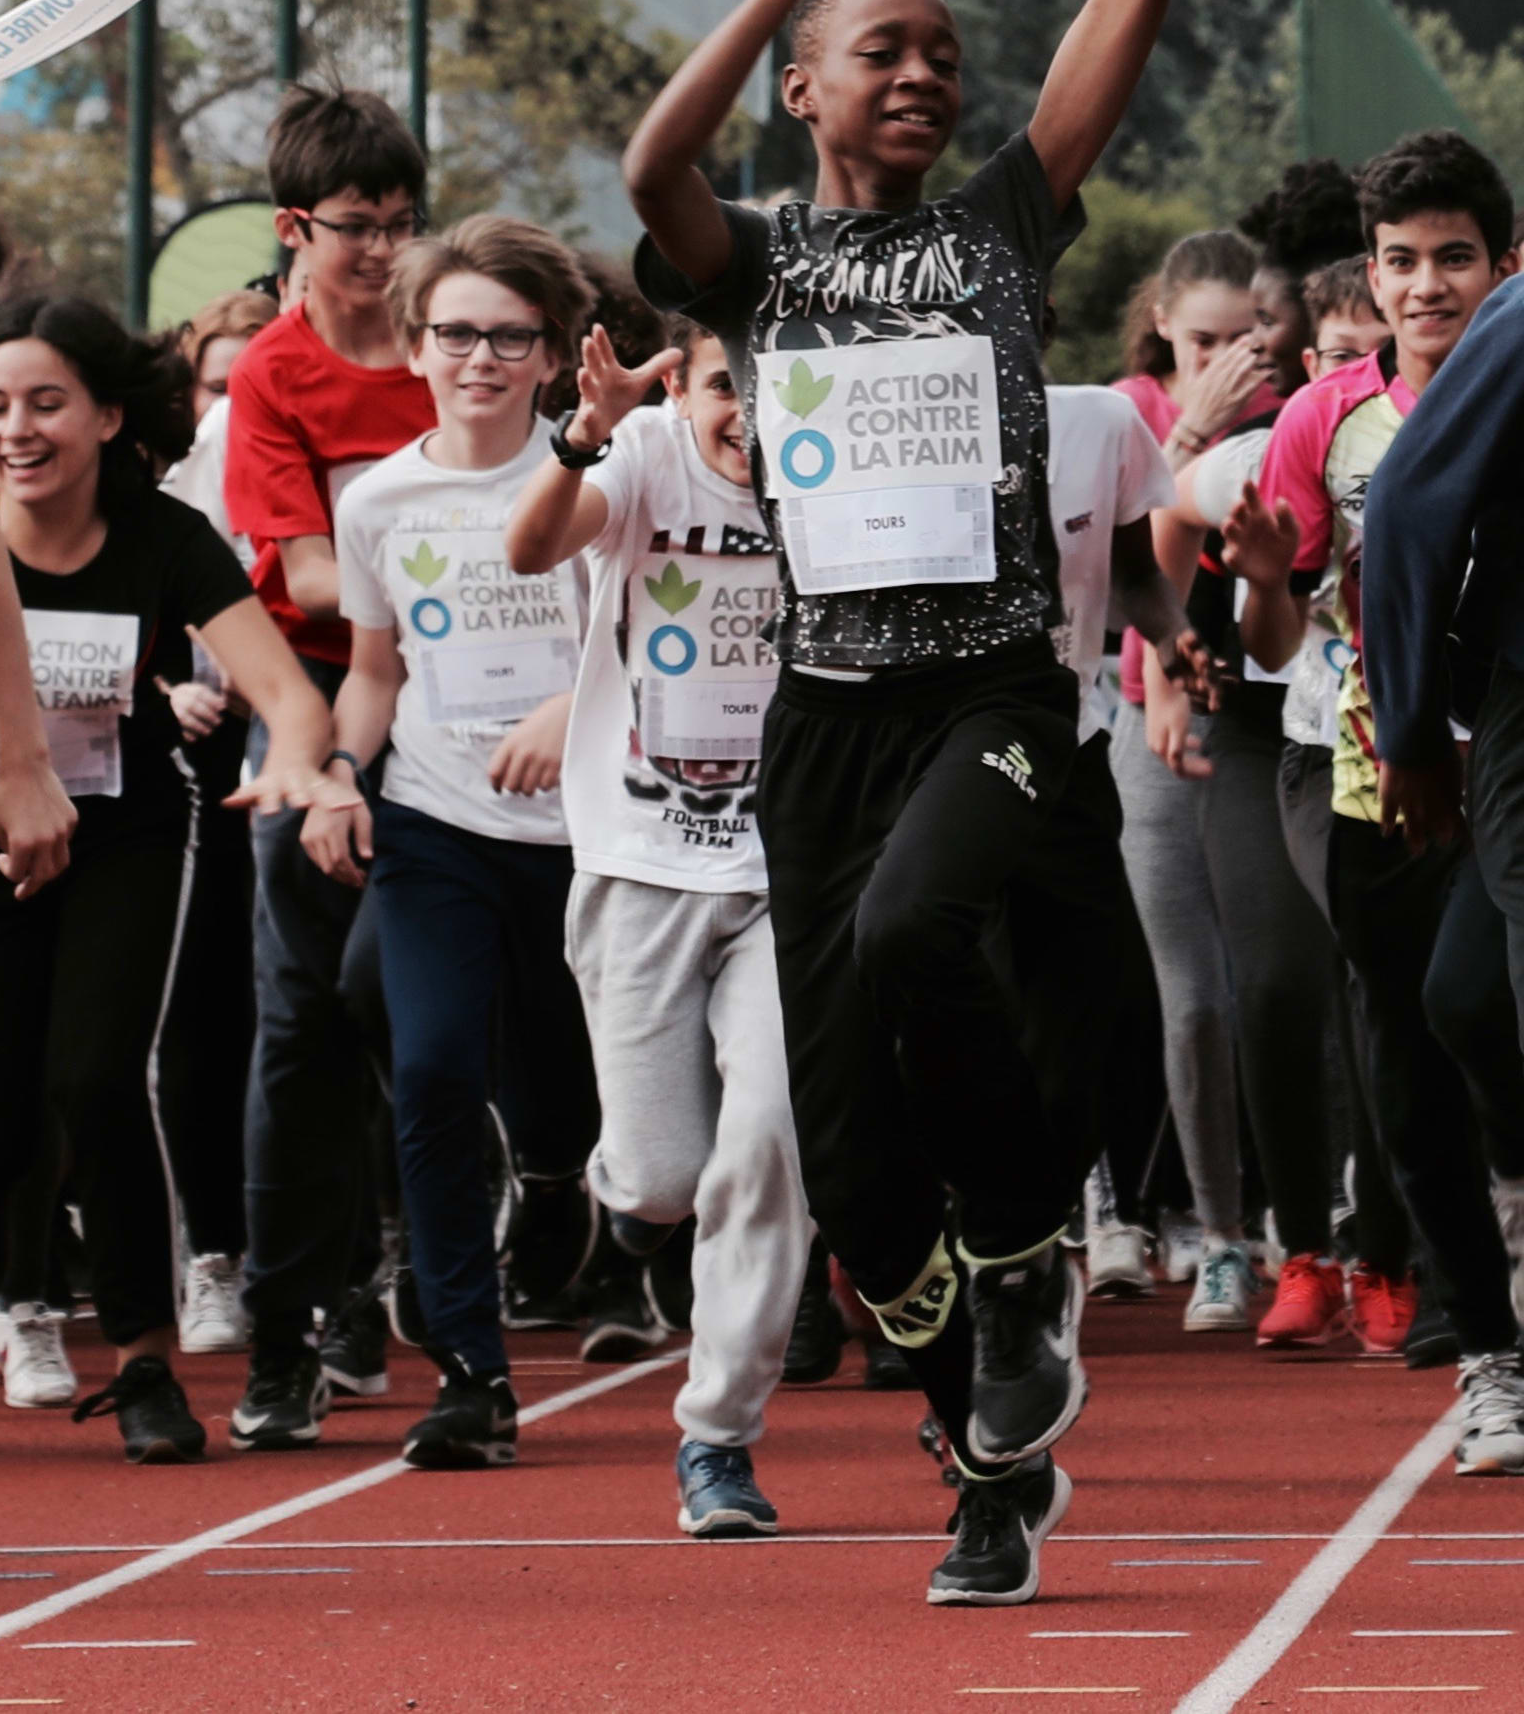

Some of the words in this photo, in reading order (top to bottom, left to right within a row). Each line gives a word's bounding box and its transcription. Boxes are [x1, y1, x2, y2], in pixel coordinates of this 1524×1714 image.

[845, 372, 979, 407] ACTION
[846, 405, 980, 436] CONTRE
[849, 441, 892, 471] LA
[899, 437, 983, 467] FAIM
[864, 516, 906, 531] TOURS
[460, 582, 560, 605] CONTRE
[464, 611, 494, 631] LA
[501, 605, 565, 629] FAIM
[29, 640, 123, 664] CTION
[710, 643, 748, 667] LA
[33, 665, 120, 689] ONTRE
[485, 667, 514, 679] TOURS
[722, 704, 758, 714] TOURS
[682, 828, 734, 849] TEAM
